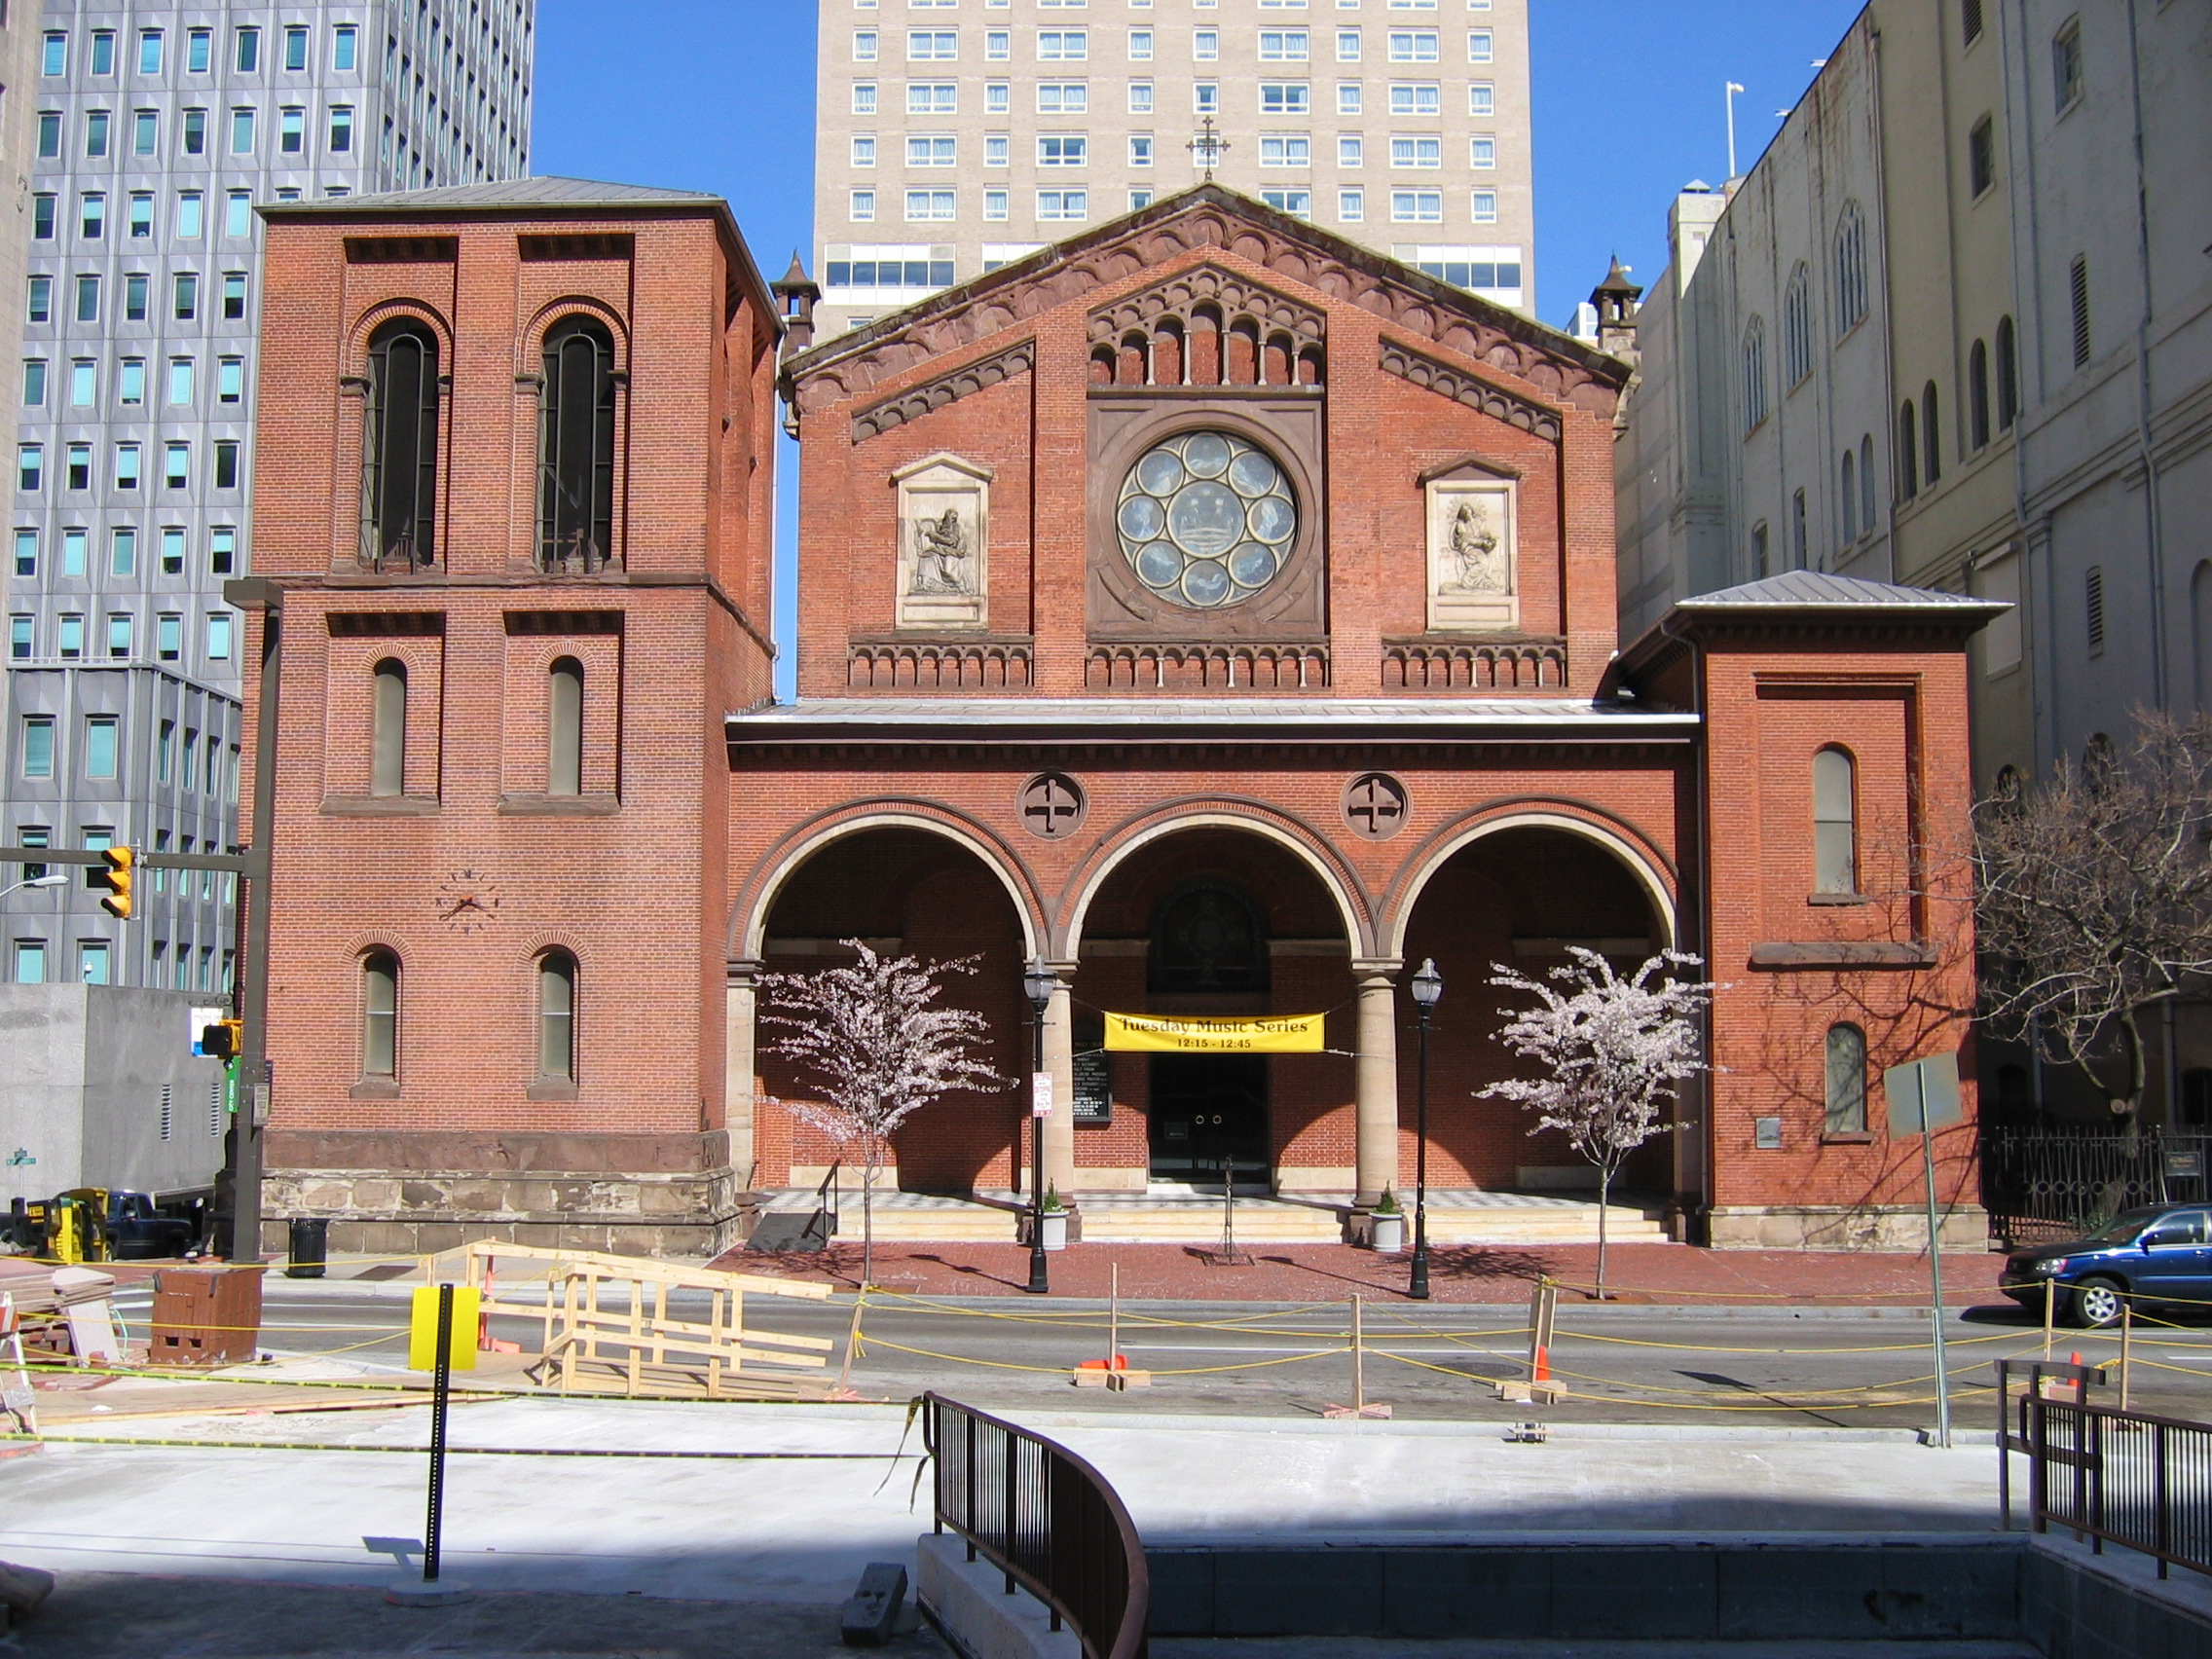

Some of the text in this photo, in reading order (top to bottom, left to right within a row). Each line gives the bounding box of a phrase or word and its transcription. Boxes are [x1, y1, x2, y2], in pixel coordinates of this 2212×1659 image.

[1120, 1017, 1309, 1035] Tuesday Music Series
[1177, 1038, 1208, 1048] 12:15
[1220, 1039, 1251, 1049] 12:45
